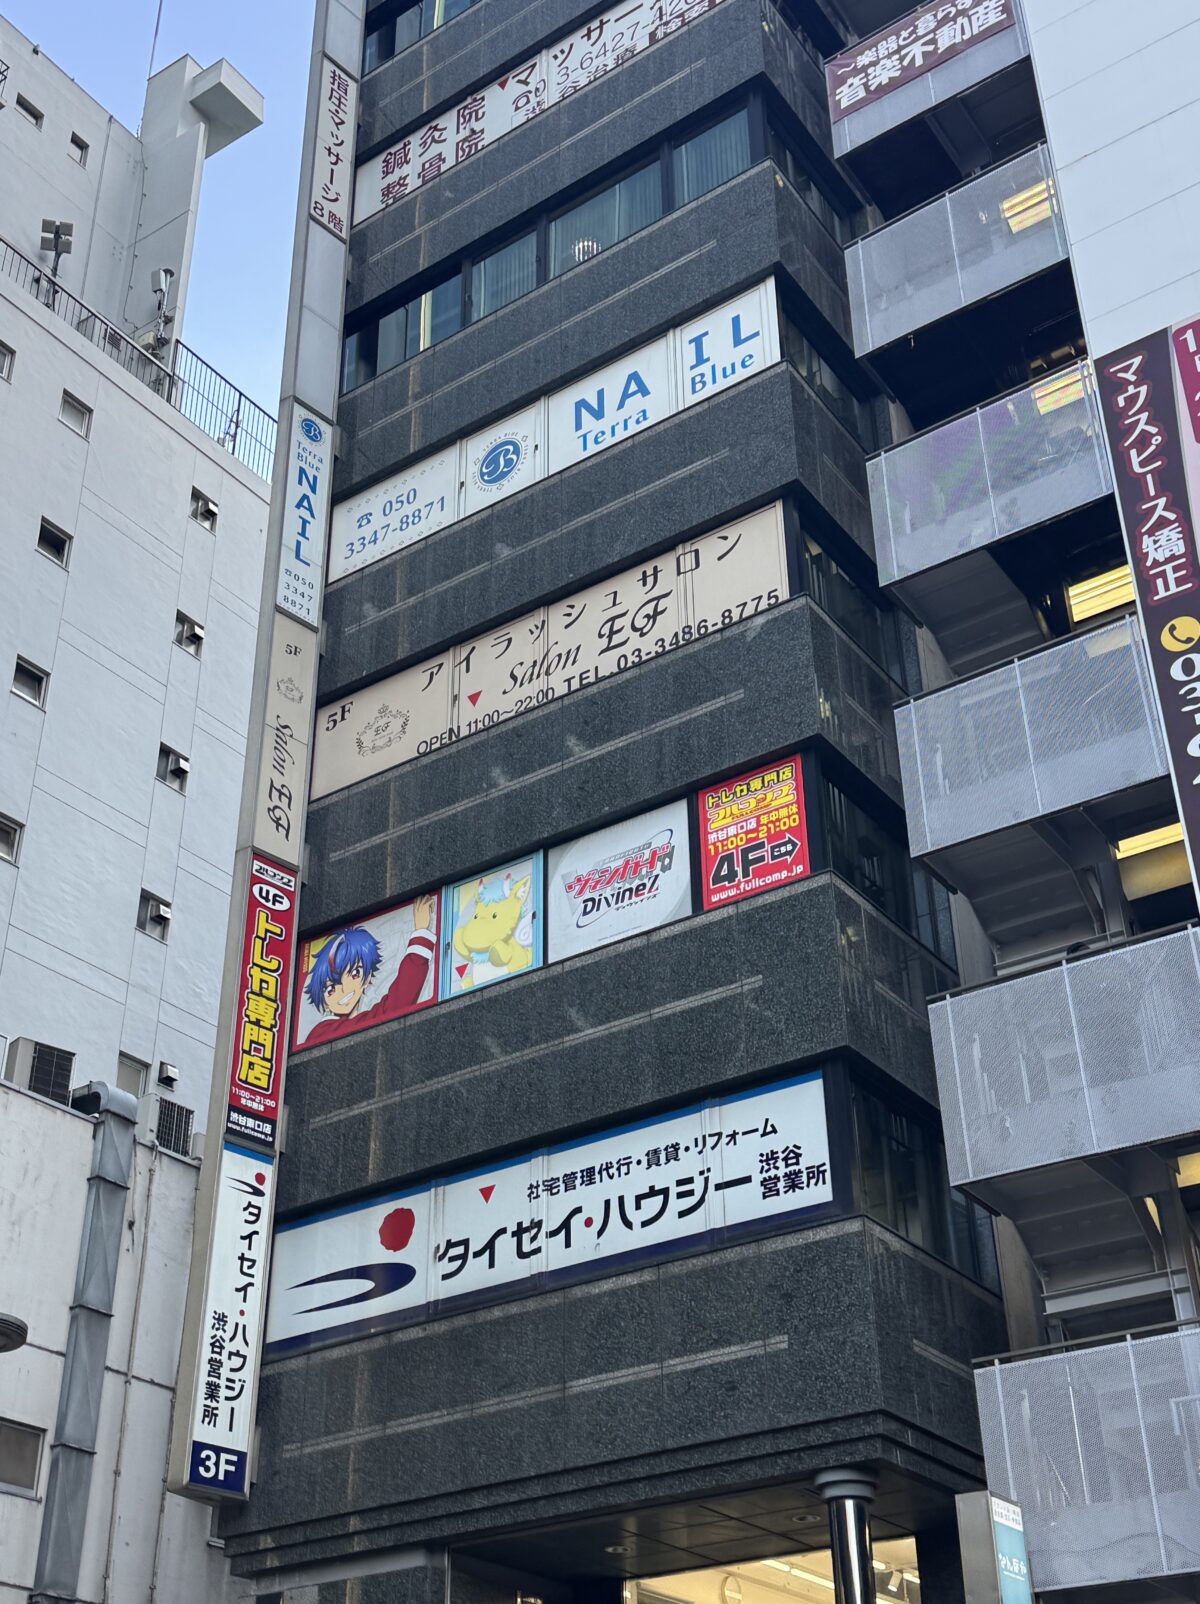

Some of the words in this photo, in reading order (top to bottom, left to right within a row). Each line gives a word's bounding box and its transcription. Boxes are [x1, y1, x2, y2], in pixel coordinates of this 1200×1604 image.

[512, 0, 661, 87] マッサー
[835, 0, 1007, 109] 音楽不動産
[322, 69, 350, 203] 指圧・マッサージ
[381, 95, 486, 180] 鍼灸院
[380, 128, 485, 206] 整骨院
[577, 408, 650, 452] Terra
[690, 353, 755, 395] Blue
[296, 440, 324, 465] Terra
[297, 452, 321, 474] Blue
[1109, 355, 1192, 601] マウスピース矯正
[294, 466, 318, 567] NAIL
[382, 488, 417, 517] 050
[344, 496, 445, 560] 3347-8871
[283, 595, 311, 615] 8871
[284, 583, 313, 603] 3347
[421, 533, 742, 692] アイラッシュサロン
[285, 643, 302, 657] 5F
[502, 634, 582, 695] Salon
[325, 701, 354, 732] 5F
[416, 725, 460, 755] OPEN
[708, 765, 794, 809] トレカ専門店
[708, 818, 757, 844] 渋谷東口店
[760, 804, 798, 824] 年中無休
[711, 839, 767, 888] 4F
[774, 844, 793, 856] こちら
[258, 885, 285, 907] 4F
[711, 864, 804, 902] www.fullcomp.jp
[237, 909, 284, 1092] トレカ専門店
[230, 1111, 273, 1135] 渋谷東口店
[527, 1118, 778, 1203] 社宅管理代行・賃貸・リフォーム
[759, 1144, 803, 1174] 渋谷
[760, 1162, 828, 1200] 営業所
[437, 1167, 753, 1282] タイセイ・ハウジー
[225, 1201, 262, 1433] タイセイ・ハウジー
[201, 1310, 227, 1428] 渋谷営業所
[198, 1450, 238, 1482] 3F
